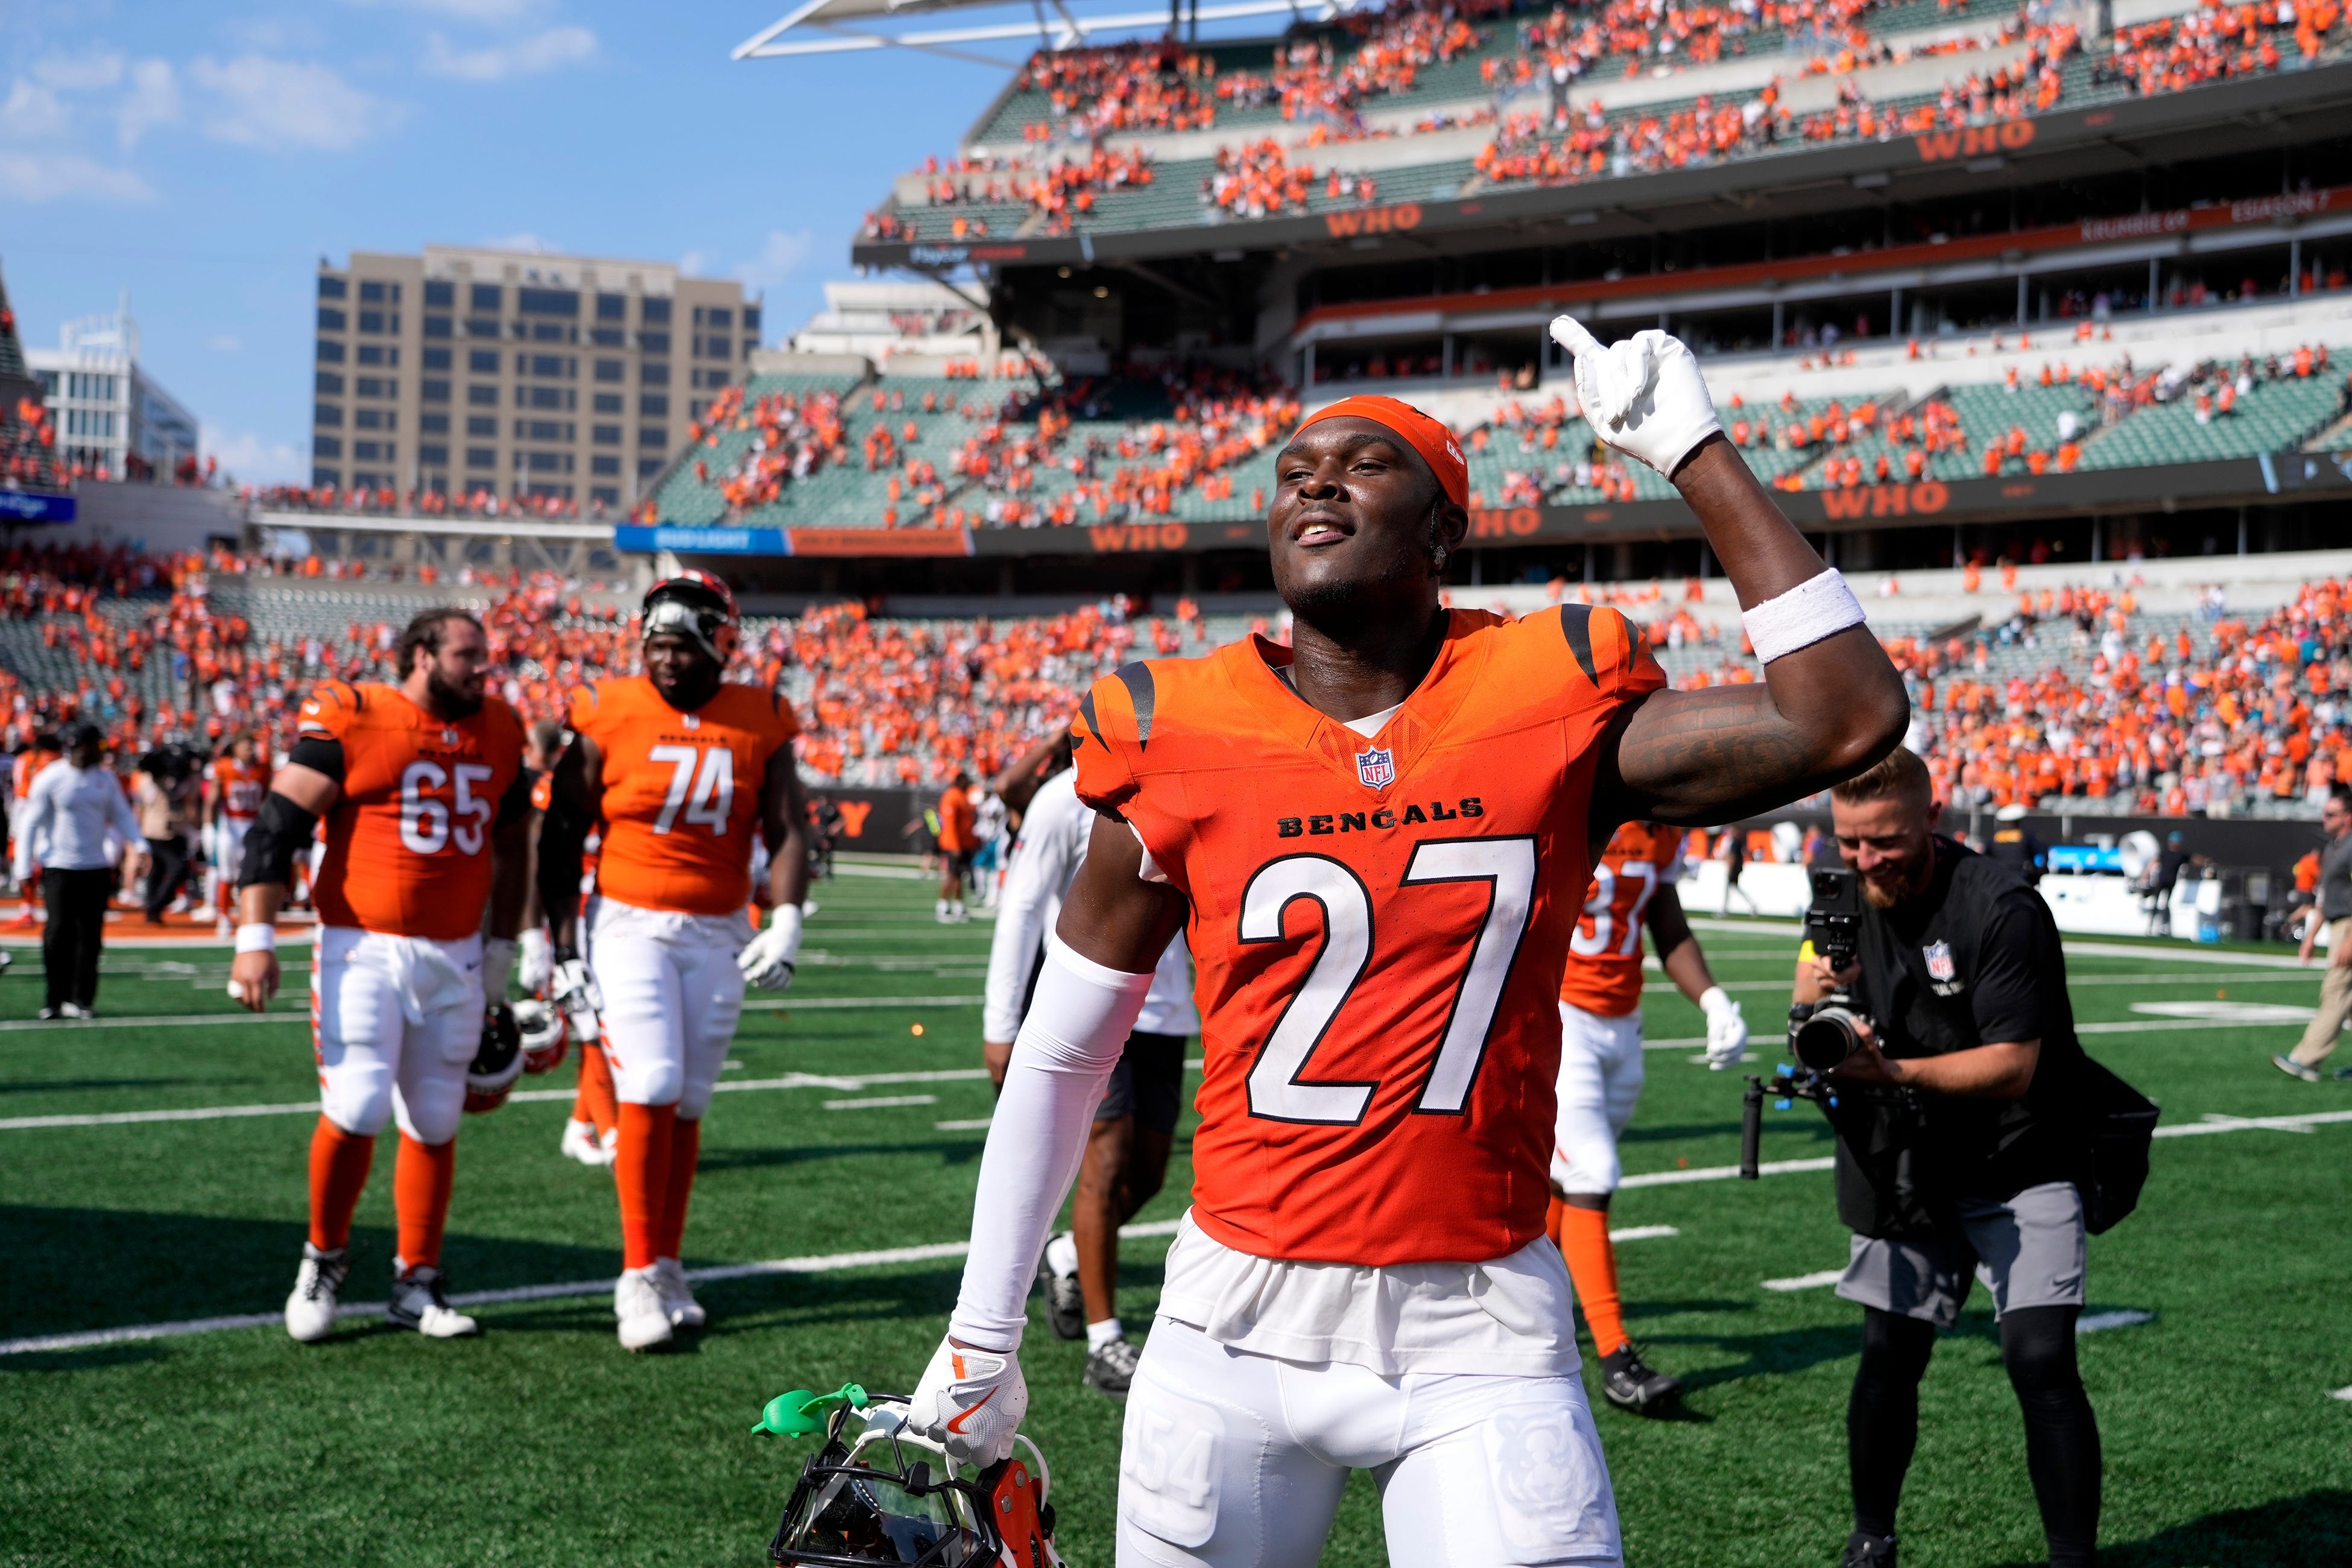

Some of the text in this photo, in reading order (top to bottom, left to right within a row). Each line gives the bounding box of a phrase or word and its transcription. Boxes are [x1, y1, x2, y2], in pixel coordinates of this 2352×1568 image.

[1916, 120, 2035, 162] WHO
[1326, 204, 1421, 237] WHO
[1821, 481, 1949, 520] WHO
[1089, 523, 1187, 551] WHO
[1469, 507, 1540, 537] HO
[650, 744, 734, 836] 74
[1364, 764, 1389, 782] NFL
[400, 760, 493, 855] 65
[1277, 797, 1484, 838] BENGALS
[1569, 861, 1657, 956] 37
[1238, 833, 1539, 1126] 27
